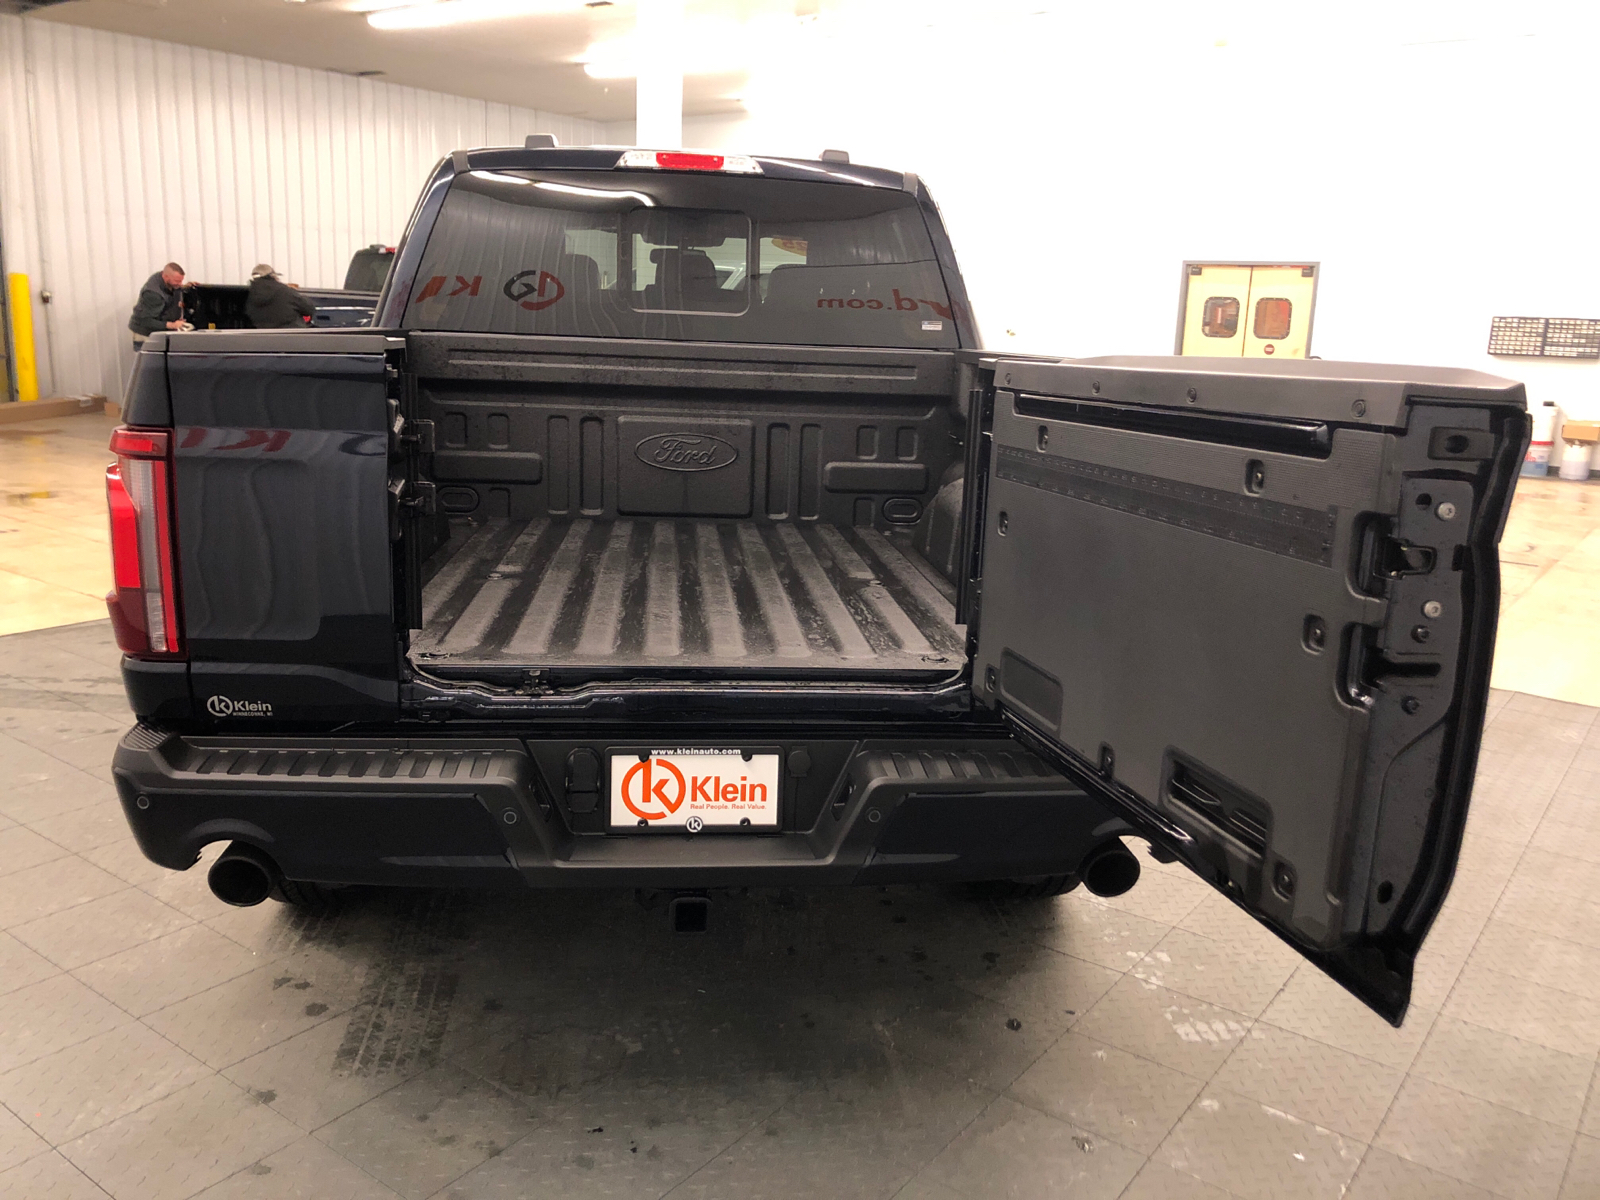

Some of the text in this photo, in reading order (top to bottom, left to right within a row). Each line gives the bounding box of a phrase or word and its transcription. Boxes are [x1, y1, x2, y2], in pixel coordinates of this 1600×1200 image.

[654, 437, 718, 464] Ford
[233, 700, 272, 711] Klein
[691, 776, 767, 802] Klein
[706, 803, 729, 811] People.
